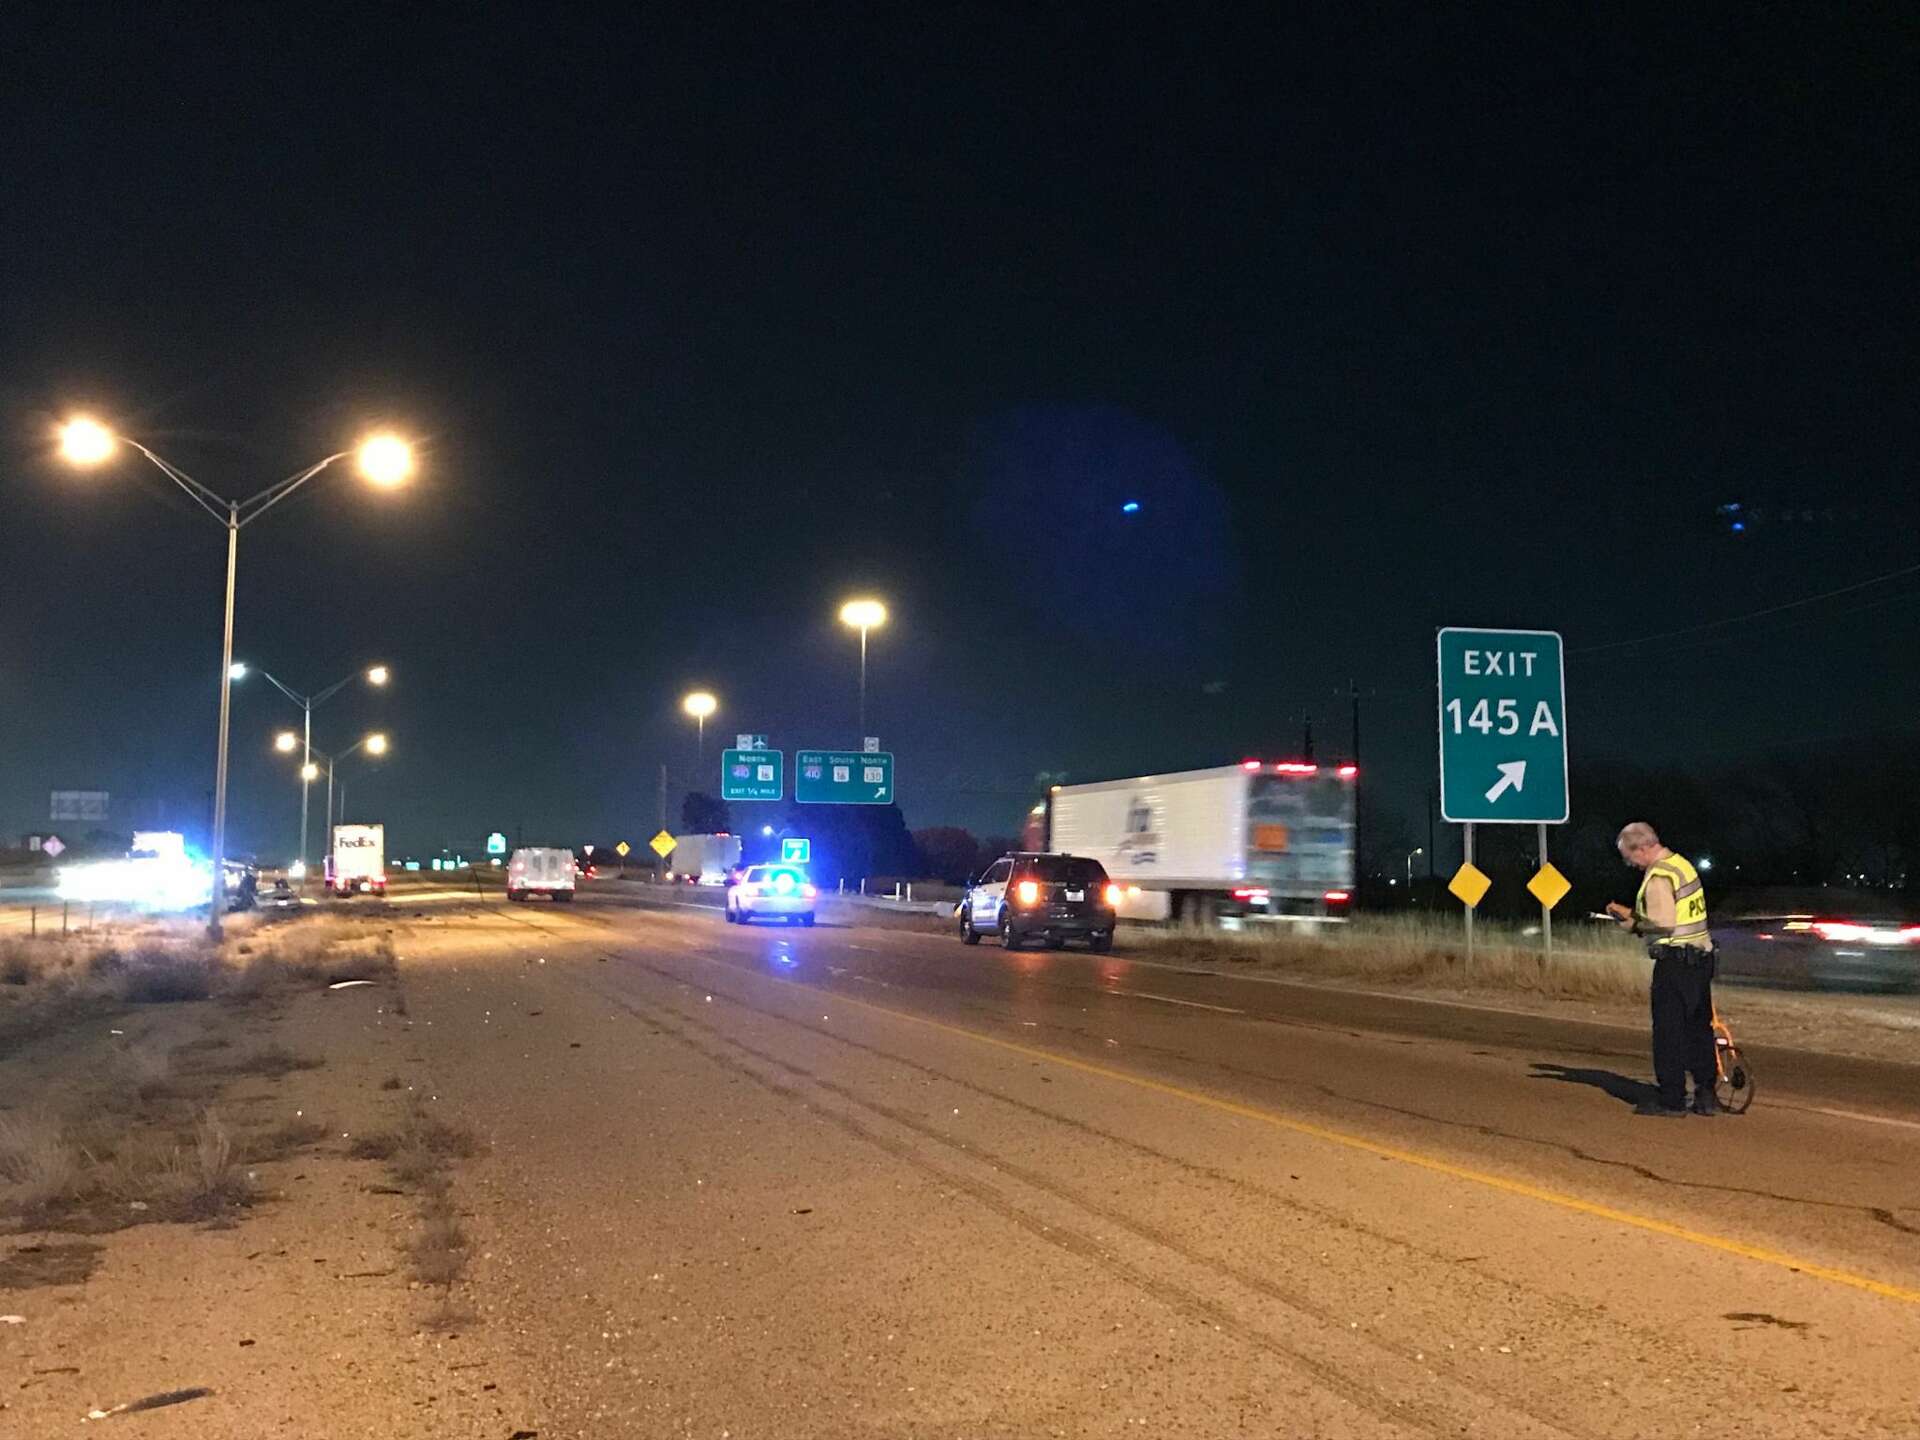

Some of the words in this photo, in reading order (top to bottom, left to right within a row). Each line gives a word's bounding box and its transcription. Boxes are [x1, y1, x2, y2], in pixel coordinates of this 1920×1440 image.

[1464, 650, 1537, 677] EXIT
[1446, 698, 1520, 735] 145
[1529, 701, 1559, 736] A
[339, 836, 376, 848] FedEx
